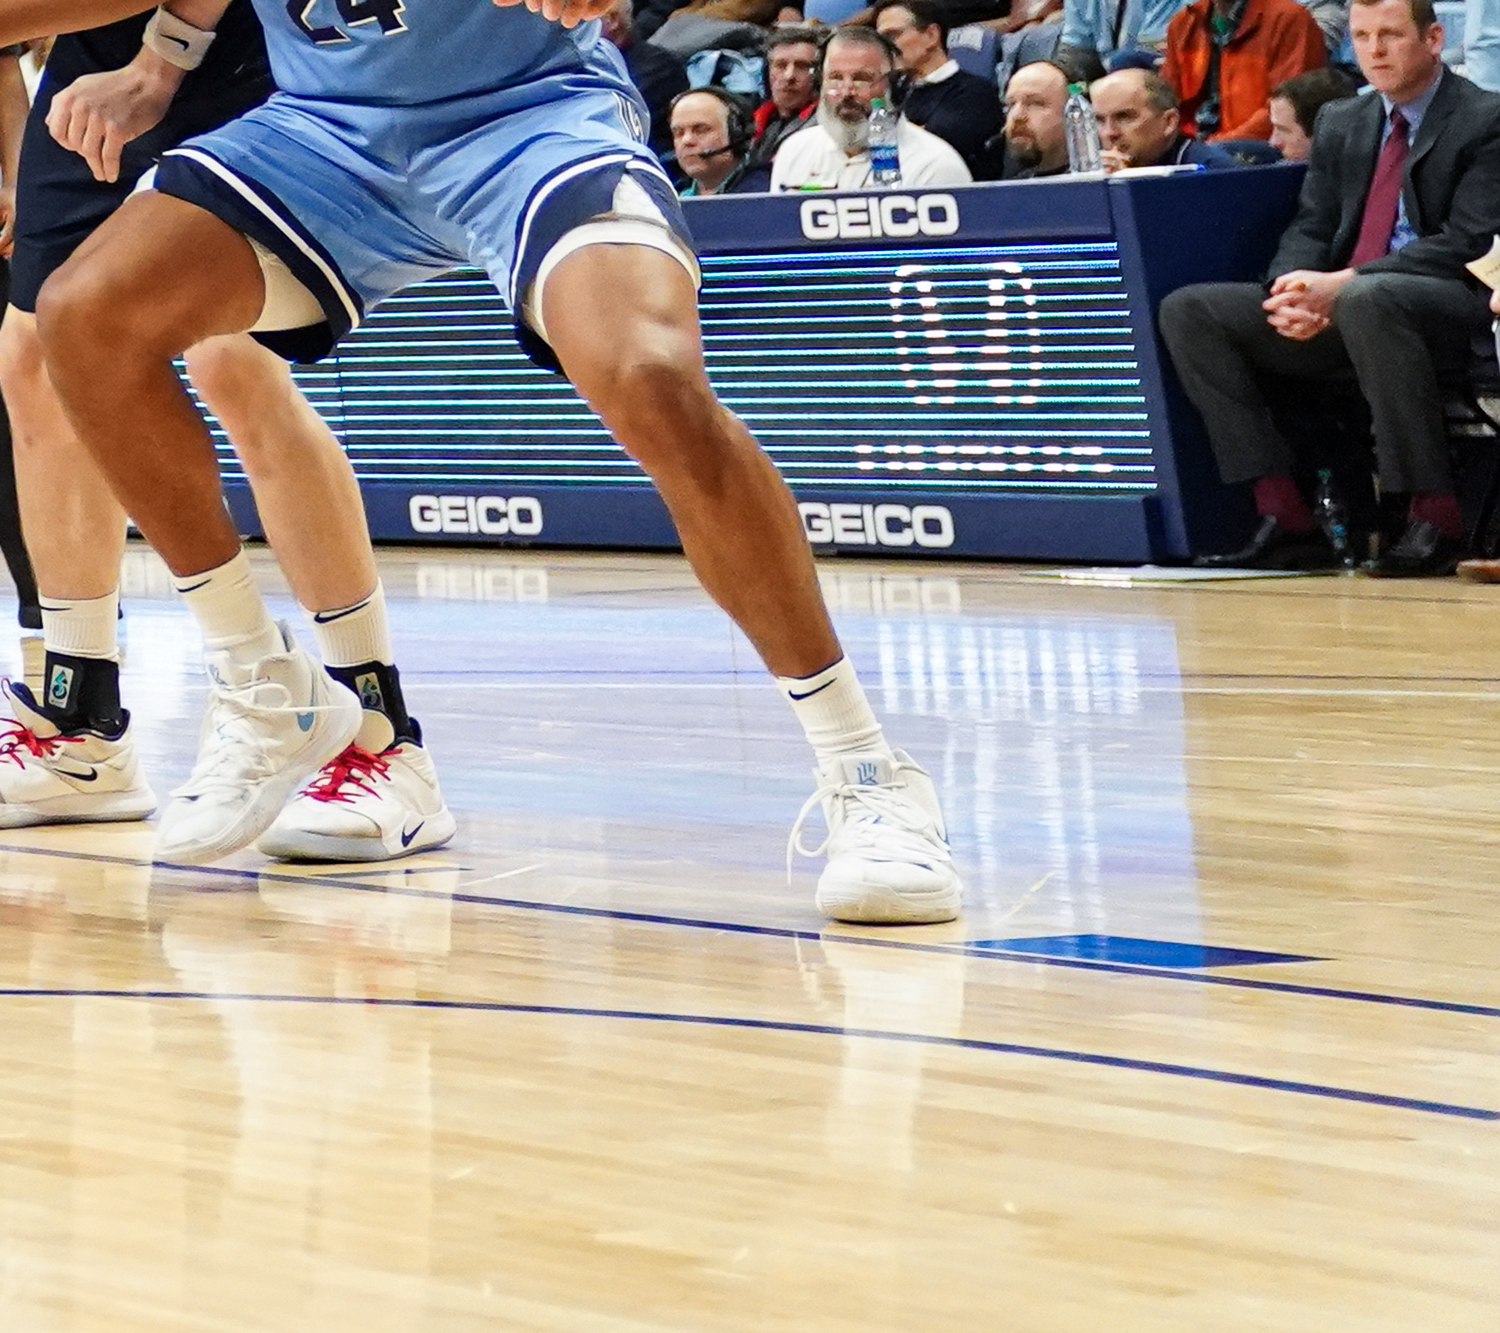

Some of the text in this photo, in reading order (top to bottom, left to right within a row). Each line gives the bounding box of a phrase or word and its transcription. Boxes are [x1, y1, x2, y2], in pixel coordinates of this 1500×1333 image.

[800, 193, 959, 239] GEICO
[409, 494, 543, 535] GEICO
[797, 502, 955, 548] GEICO
